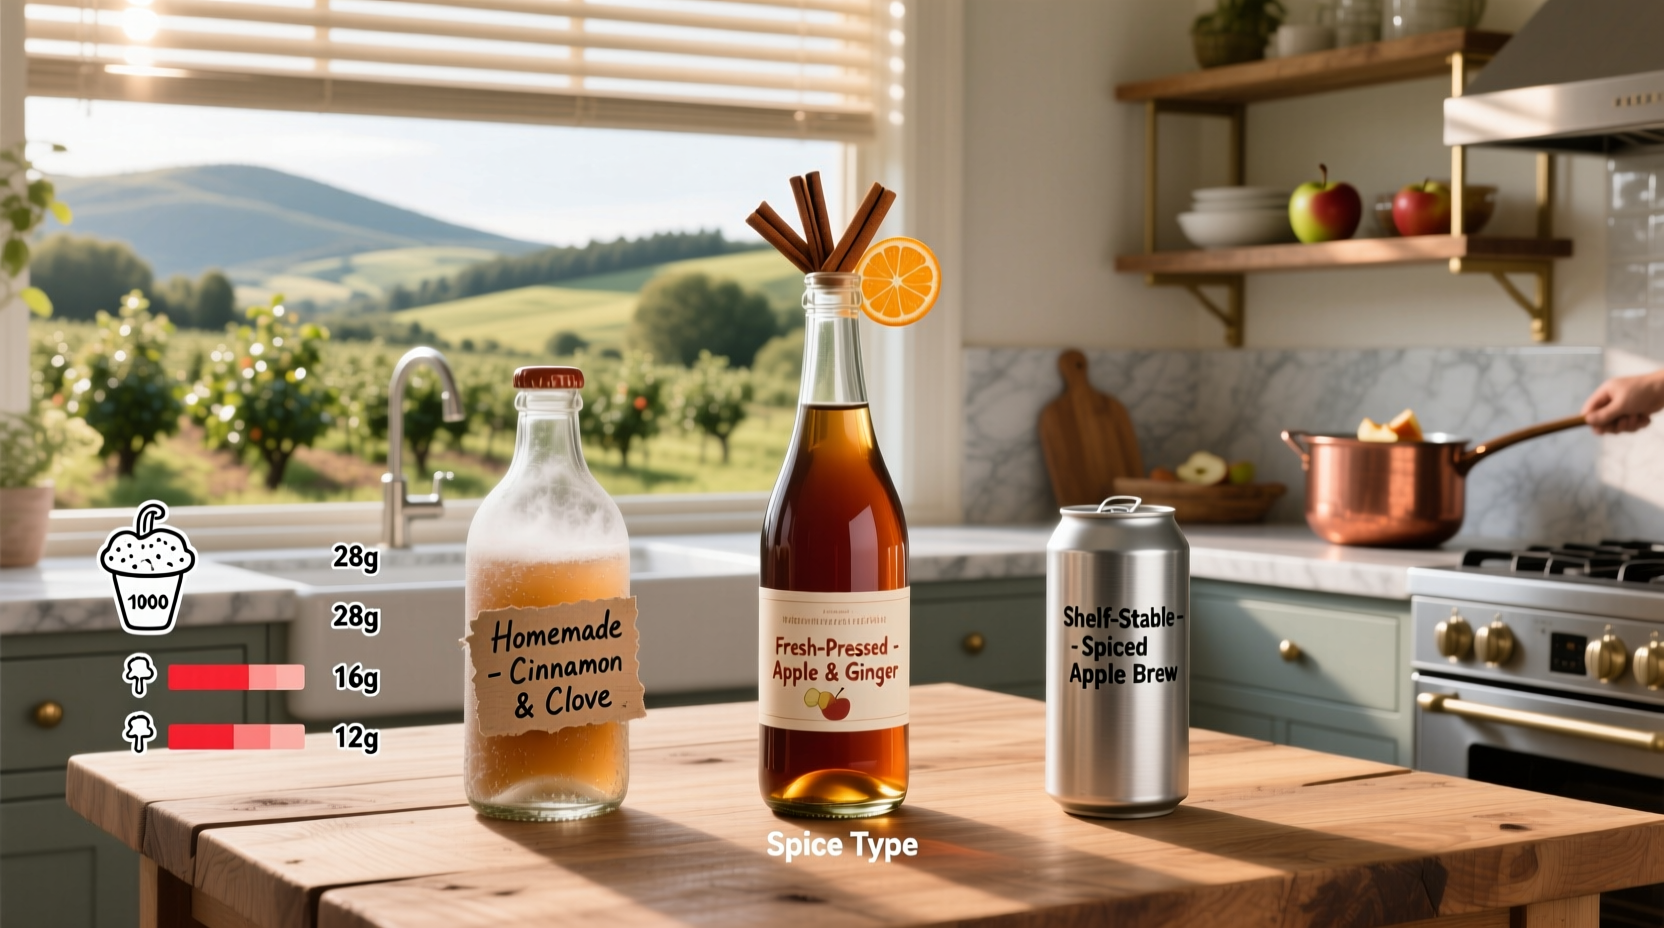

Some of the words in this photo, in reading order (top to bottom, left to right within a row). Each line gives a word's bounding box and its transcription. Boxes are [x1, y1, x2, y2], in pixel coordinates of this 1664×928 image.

[491, 609, 622, 653] Homemade
[776, 635, 888, 657] Fresh-Pressed
[510, 656, 622, 684] Cinnamon
[772, 660, 818, 687] Apple
[825, 662, 839, 681] &
[845, 661, 899, 687] Ginger
[1069, 662, 1126, 690] Apple
[1133, 663, 1178, 683] Brew
[514, 692, 534, 718] &
[545, 685, 612, 715] Clove
